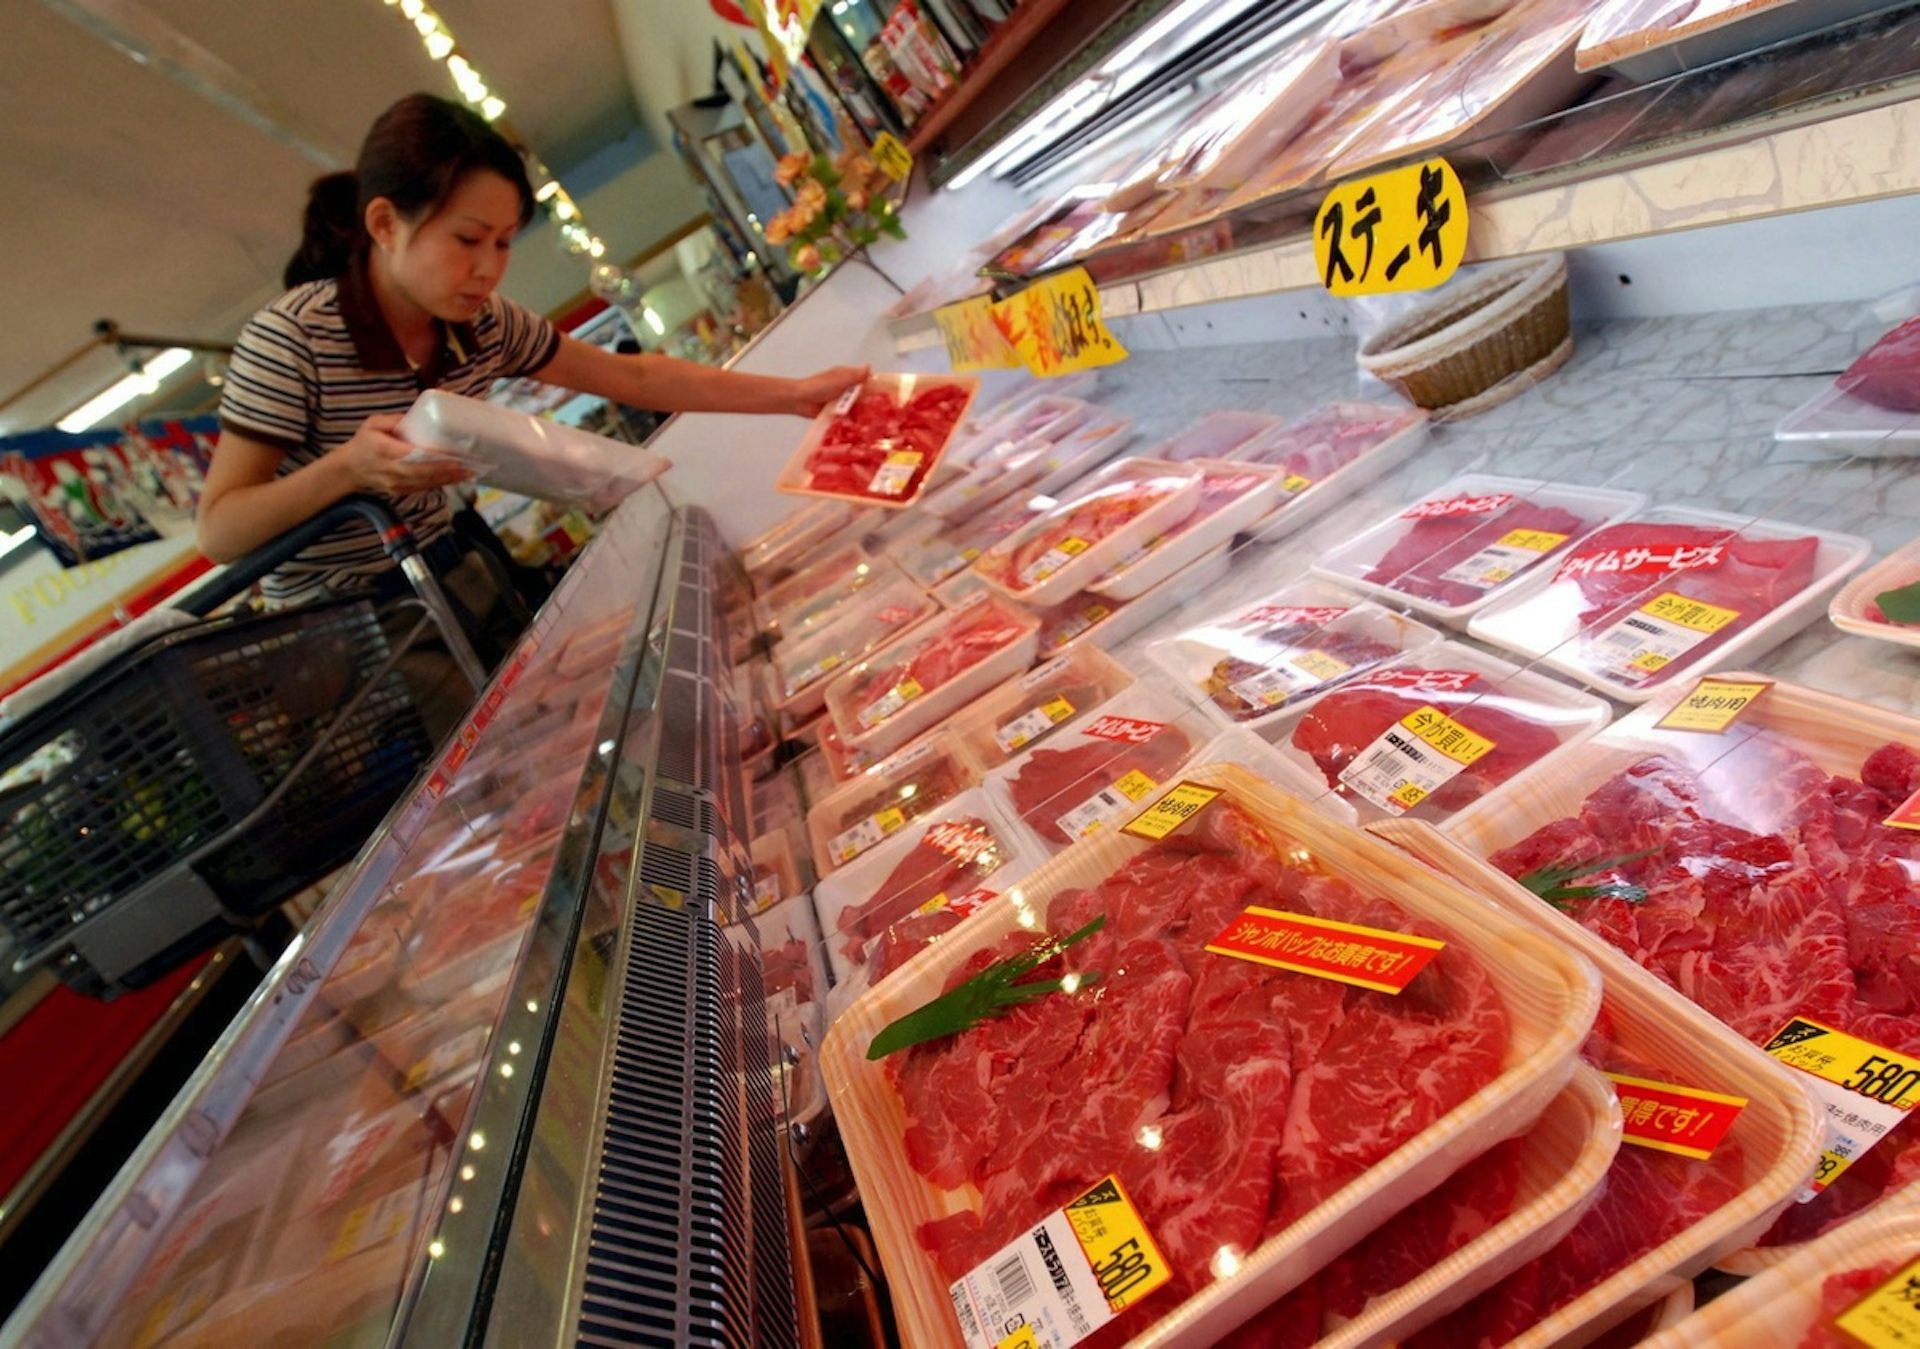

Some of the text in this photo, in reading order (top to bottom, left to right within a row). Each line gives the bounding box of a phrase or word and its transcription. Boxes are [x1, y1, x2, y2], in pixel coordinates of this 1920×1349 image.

[1321, 164, 1450, 289] ステーキ
[1557, 546, 1725, 577] タイムサービス
[1655, 597, 1730, 629] 今が買い!
[1414, 711, 1484, 761] 今が買い!
[1228, 921, 1415, 977] ジャンボパックはお買得です!
